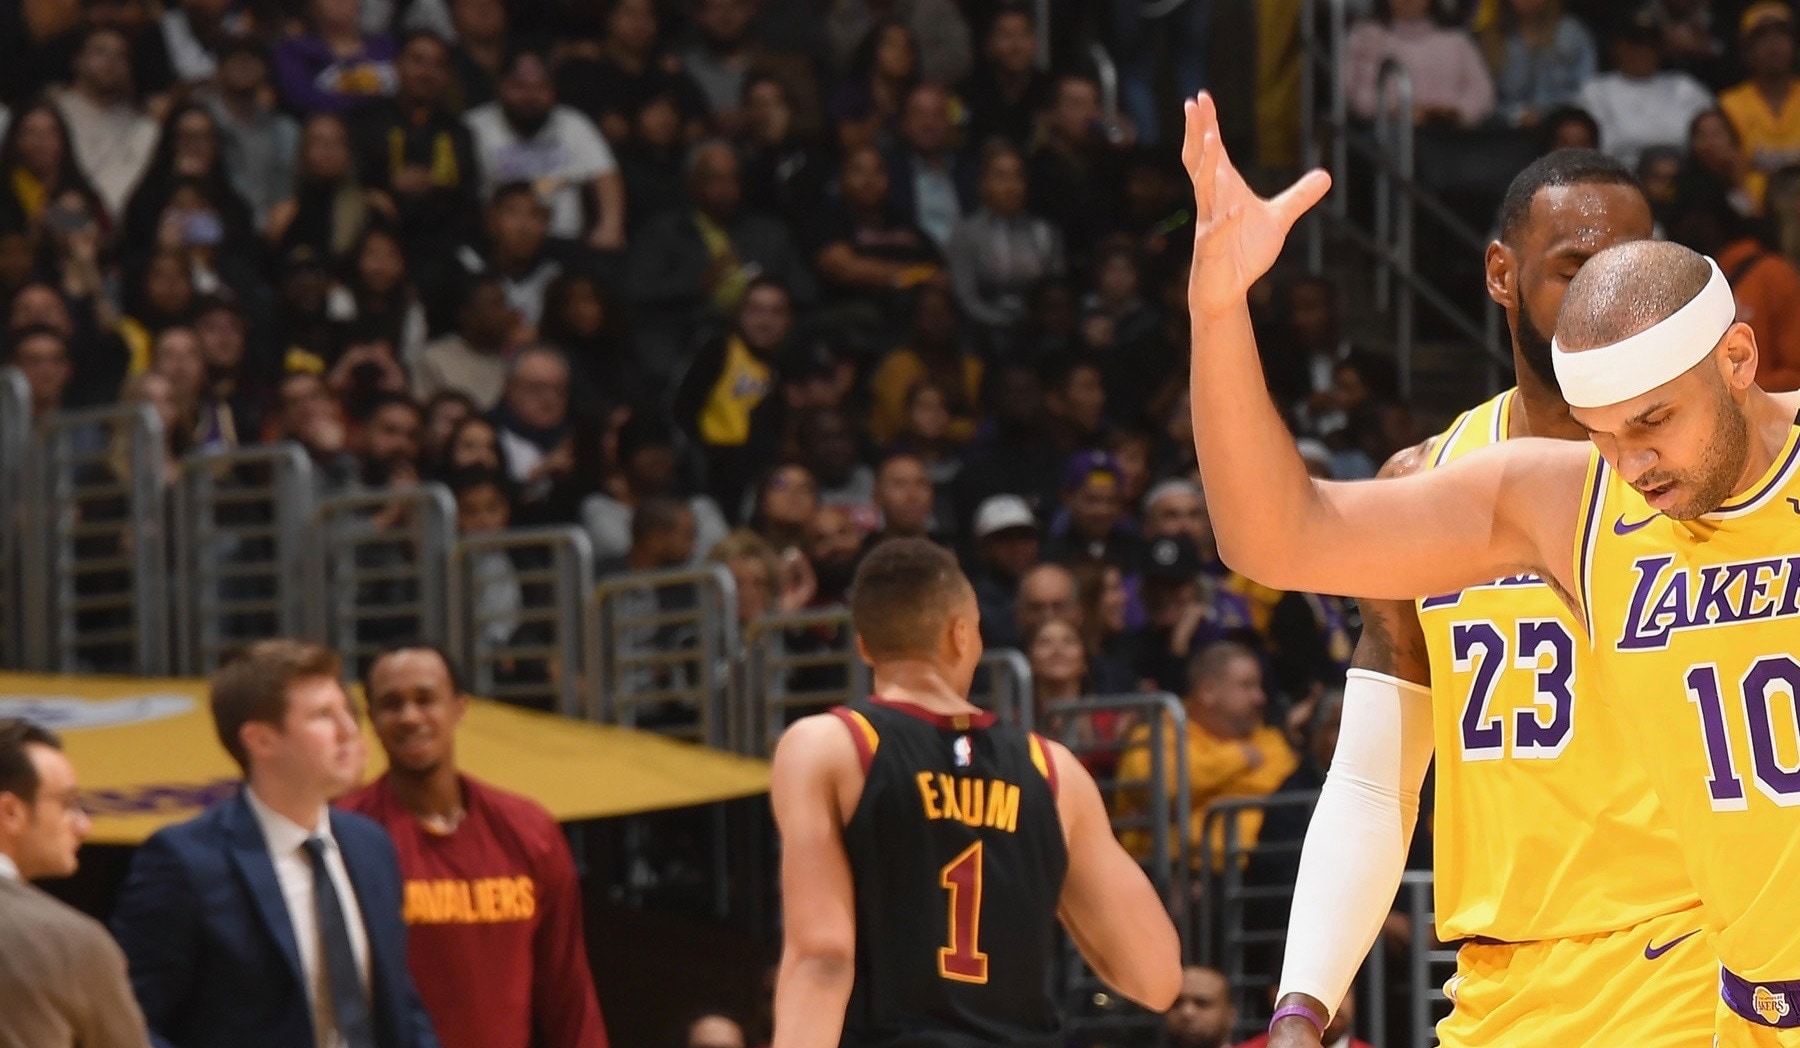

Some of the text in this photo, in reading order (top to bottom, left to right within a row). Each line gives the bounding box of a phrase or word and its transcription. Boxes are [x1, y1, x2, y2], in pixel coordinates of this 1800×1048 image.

[1450, 617, 1577, 762] 23
[915, 770, 1021, 833] EXUM
[402, 874, 535, 926] AVALIERS
[937, 839, 988, 985] 1
